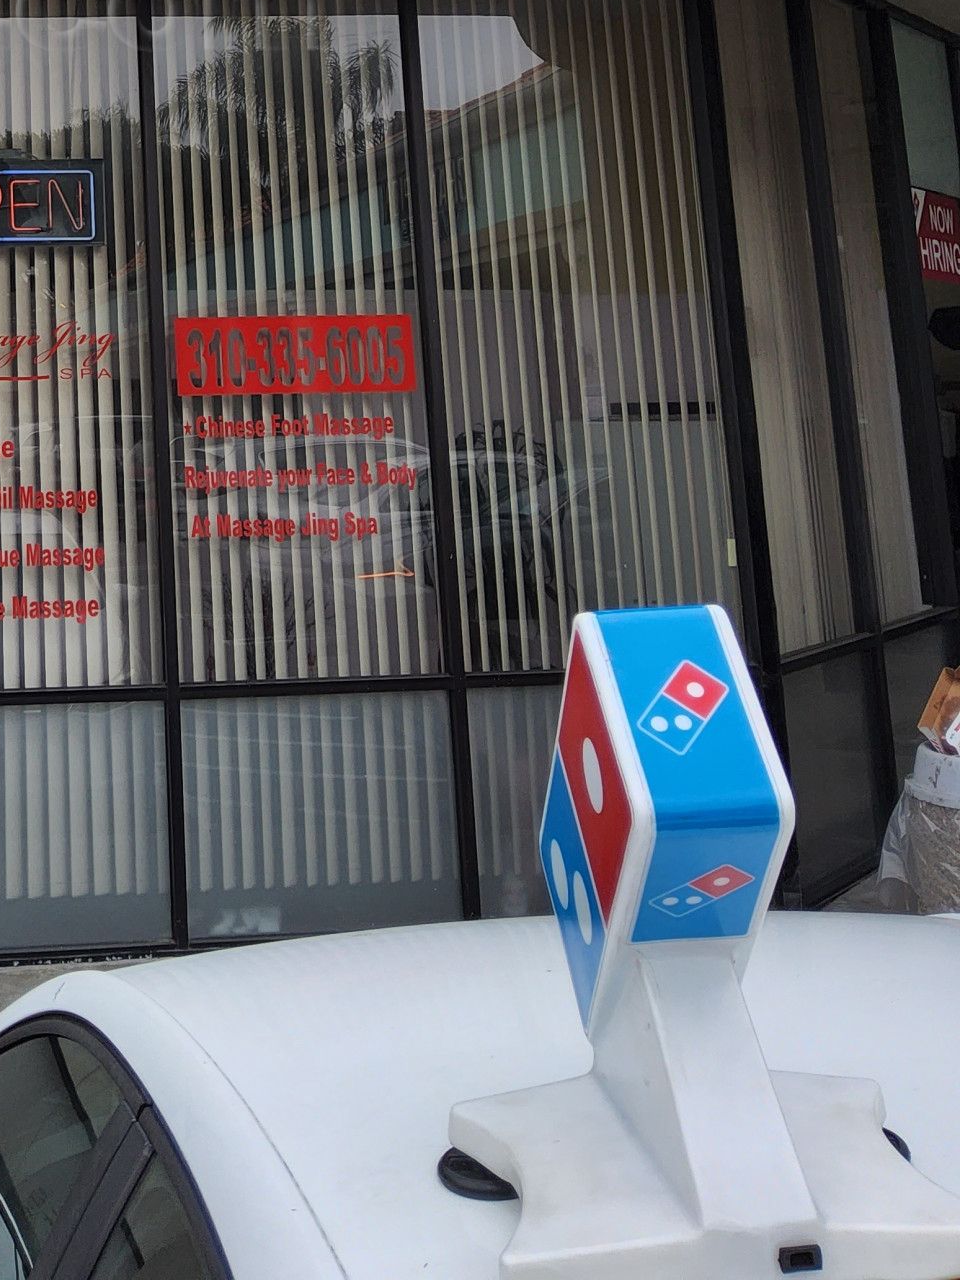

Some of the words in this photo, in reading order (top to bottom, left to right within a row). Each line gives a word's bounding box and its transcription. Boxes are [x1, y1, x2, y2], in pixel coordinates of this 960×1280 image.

[929, 204, 954, 235] NOW
[920, 236, 960, 275] HIRING
[34, 320, 116, 368] Jing
[186, 325, 406, 389] 310-335-6005
[60, 367, 112, 380] SPA
[195, 415, 266, 439] Chinese
[271, 413, 310, 437] Foot
[314, 412, 394, 440] Massage
[184, 466, 273, 495] Rejuvenate
[277, 469, 312, 494] your
[316, 463, 356, 486] Face
[360, 463, 372, 485] &
[376, 461, 417, 491] Body
[19, 485, 98, 514] Massage
[191, 515, 211, 538] At
[216, 513, 296, 542] Massage
[300, 512, 339, 541] Jing
[344, 511, 378, 541] Spa
[26, 543, 105, 571] Massage
[12, 596, 99, 624] Massage
